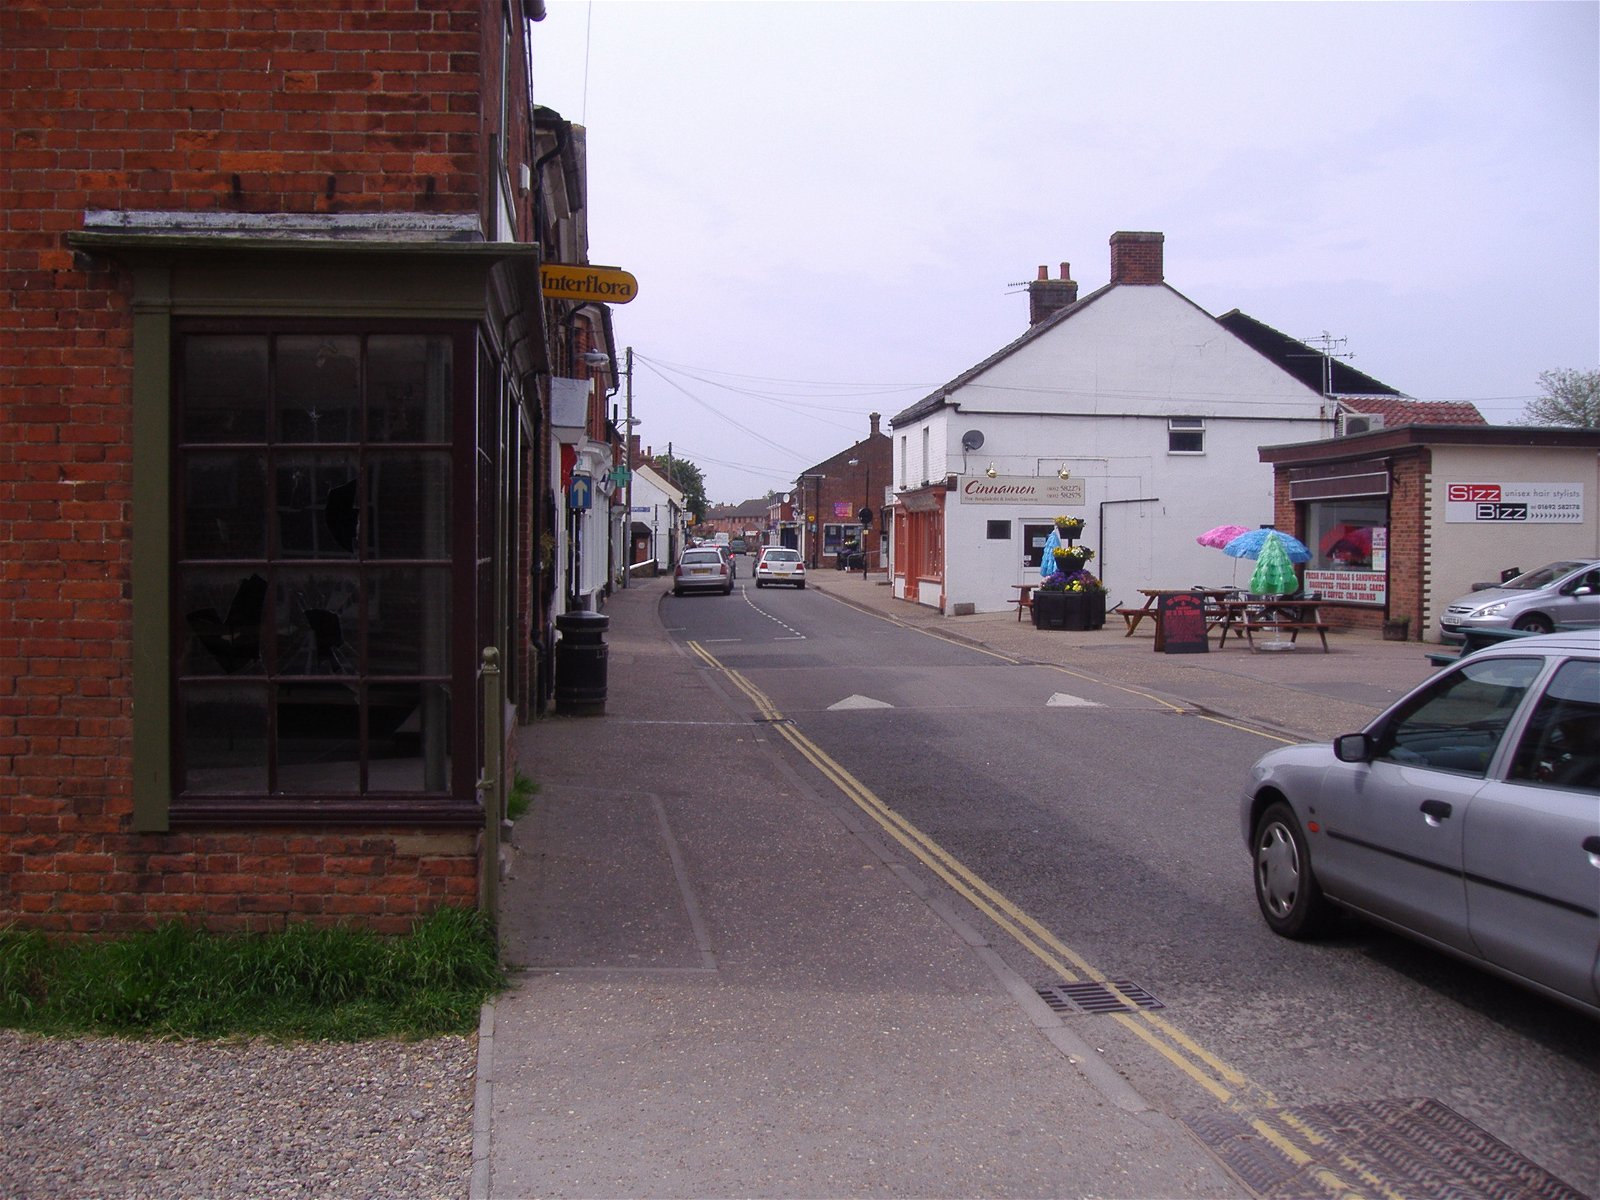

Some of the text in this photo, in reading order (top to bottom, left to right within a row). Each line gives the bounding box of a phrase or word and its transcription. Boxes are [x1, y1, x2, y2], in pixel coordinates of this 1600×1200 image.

[542, 271, 631, 296] Interflora
[965, 480, 1036, 495] Cinnamon
[1450, 485, 1500, 501] Sizz
[1505, 489, 1580, 499] unisex hair stylists
[1477, 503, 1526, 519] Bizz
